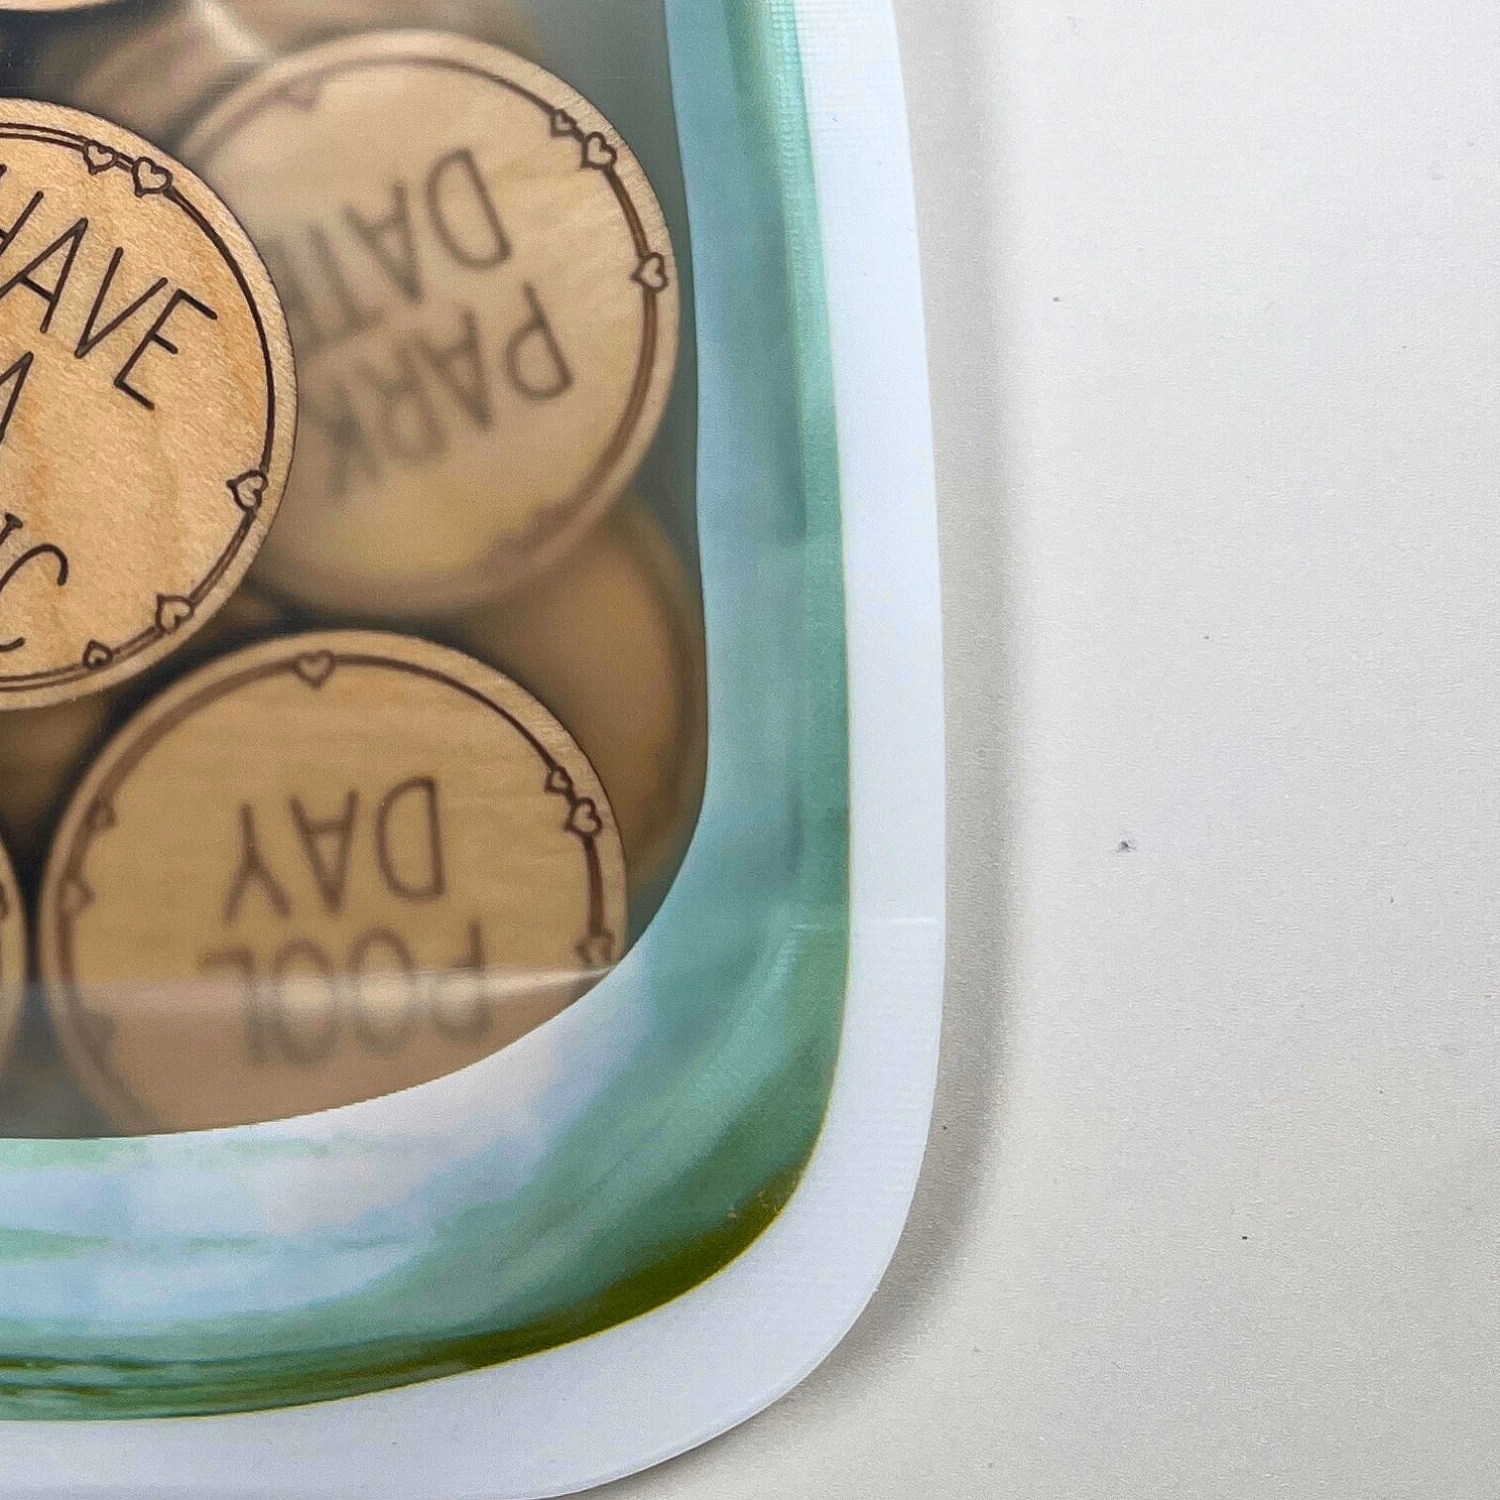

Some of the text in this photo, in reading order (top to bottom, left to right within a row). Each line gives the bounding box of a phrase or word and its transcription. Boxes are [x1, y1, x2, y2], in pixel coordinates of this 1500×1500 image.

[297, 280, 575, 498] PARK
[222, 774, 449, 927] DAY
[197, 917, 494, 1068] POOL
